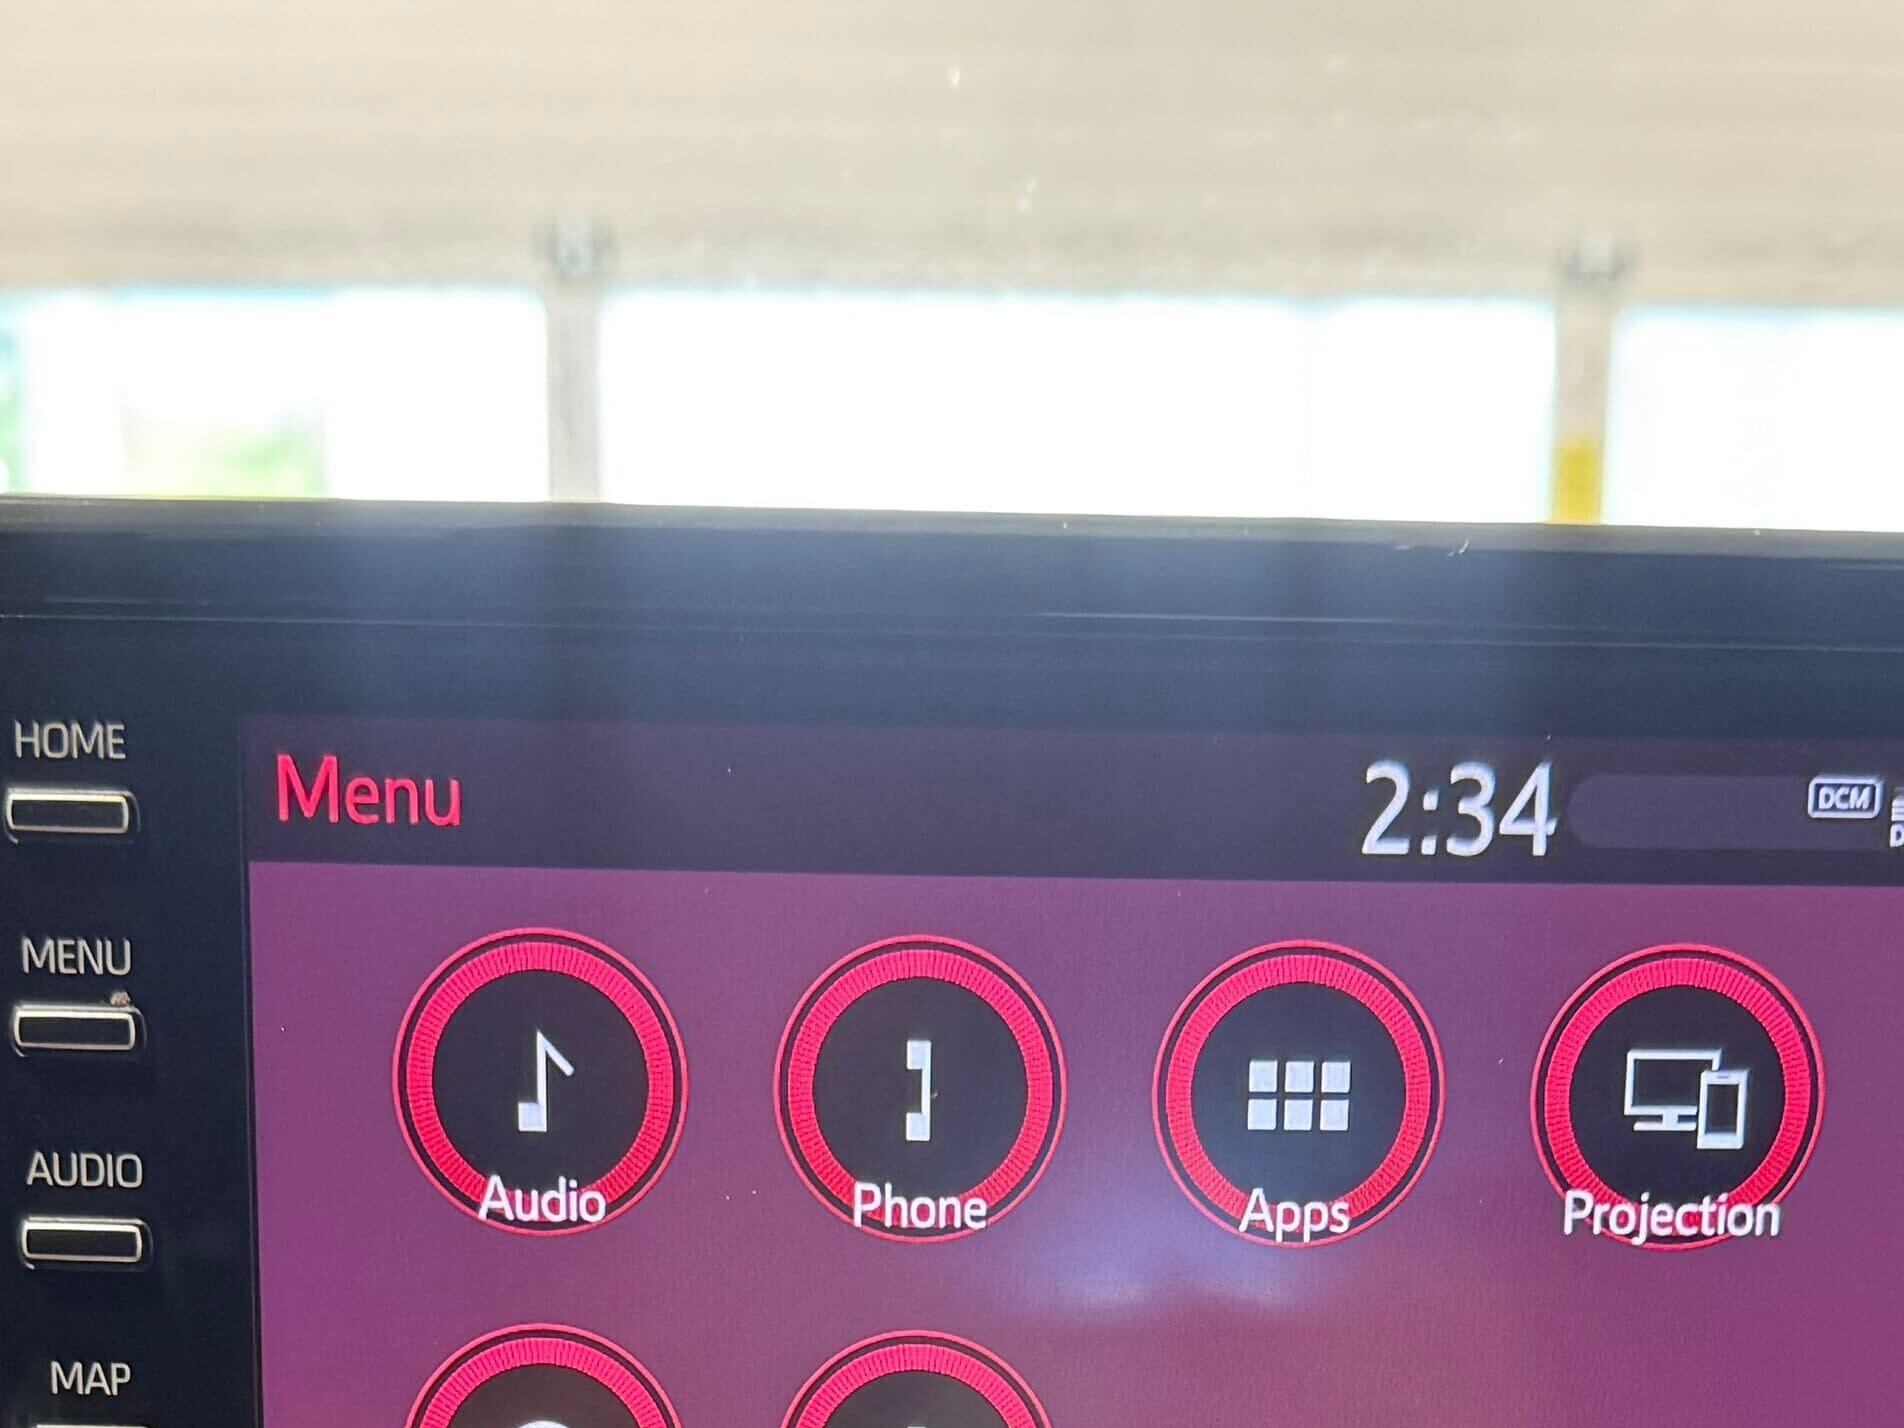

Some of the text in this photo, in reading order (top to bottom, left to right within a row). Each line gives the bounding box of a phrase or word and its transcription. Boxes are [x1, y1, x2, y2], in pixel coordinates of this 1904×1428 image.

[14, 721, 127, 759] HOME
[276, 754, 462, 827] Menu
[1360, 760, 1557, 858] 2:34
[1818, 786, 1873, 810] DCM
[21, 937, 132, 976] MENU
[26, 1152, 144, 1190] AUDIO
[478, 1175, 607, 1224] Audio
[852, 1182, 988, 1231] Phone
[1238, 1187, 1352, 1243] Apps
[1563, 1189, 1782, 1244] Projection
[49, 1360, 132, 1398] MAP
